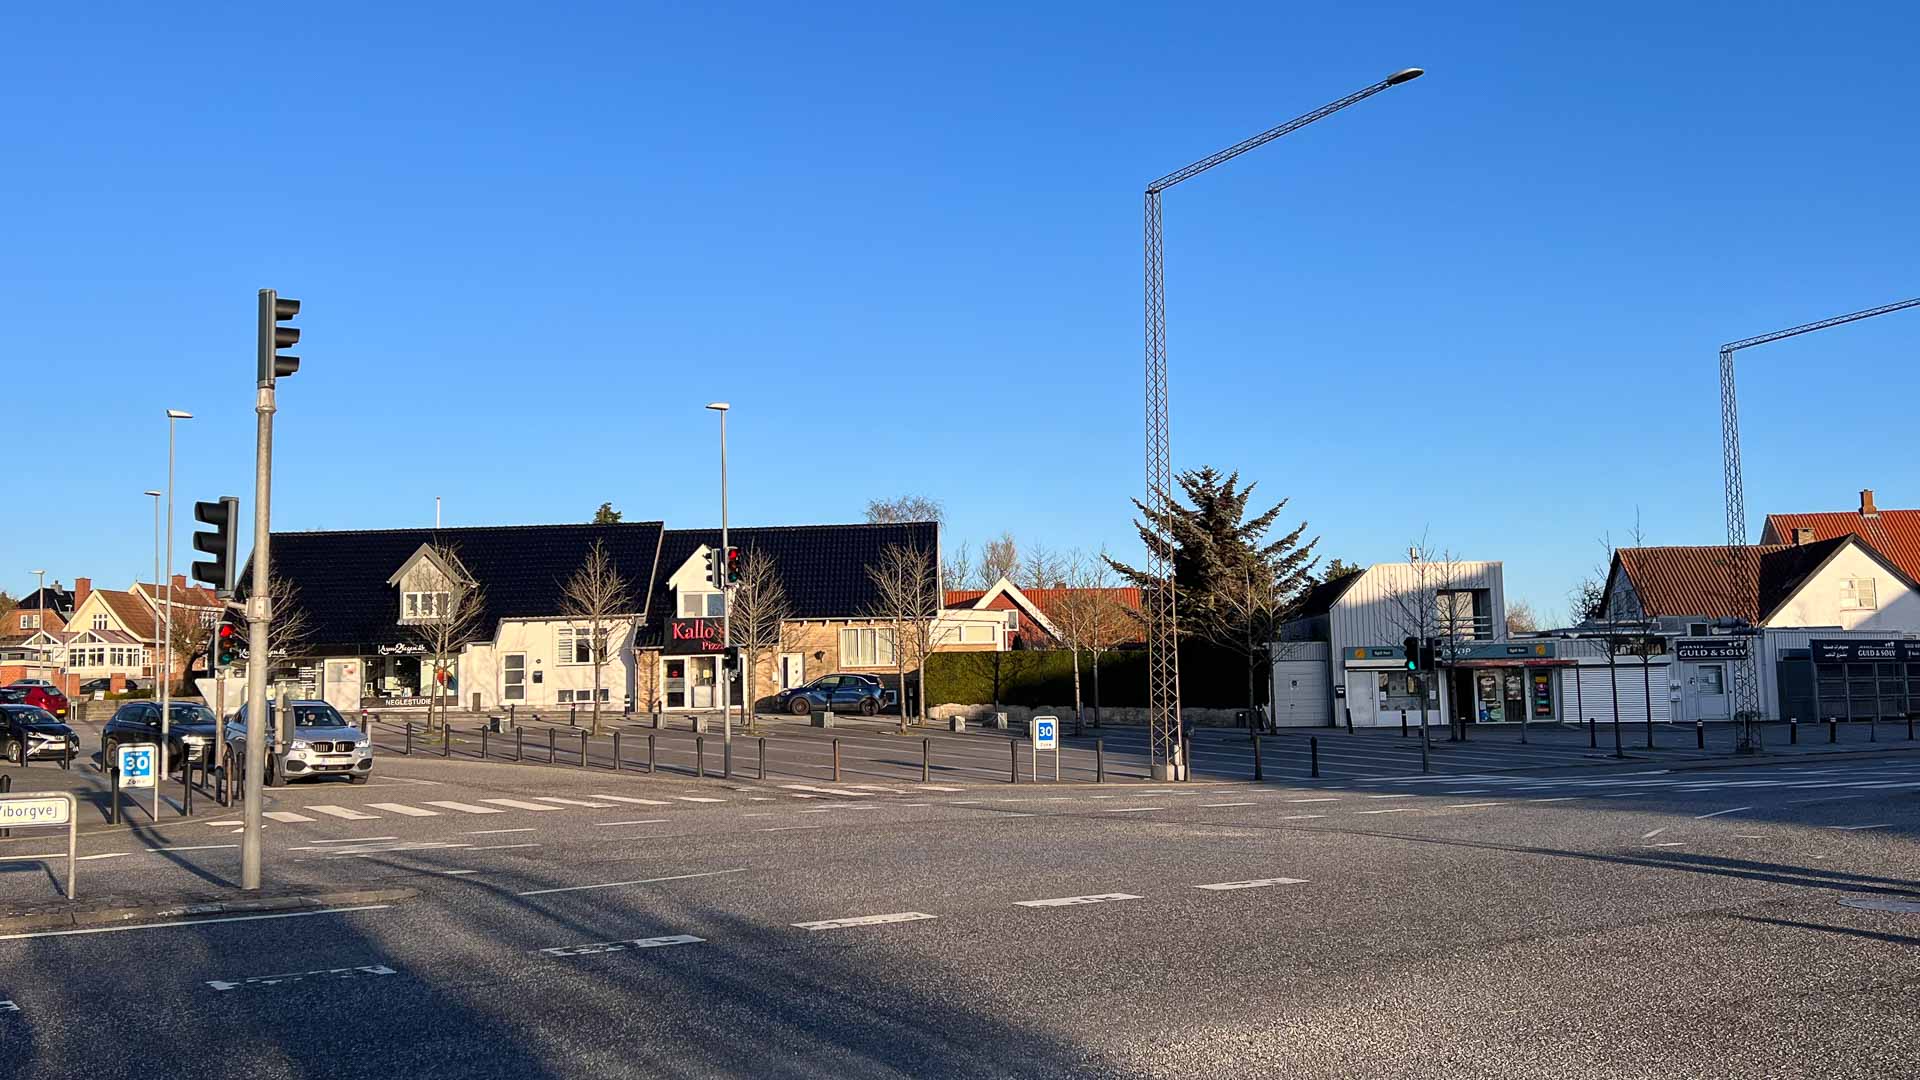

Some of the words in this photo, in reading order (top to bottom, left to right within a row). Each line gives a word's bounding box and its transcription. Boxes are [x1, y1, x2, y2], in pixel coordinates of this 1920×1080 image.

[1040, 726, 1052, 736] 30
[125, 756, 149, 770] 30
[0, 804, 58, 820] iborgvej
